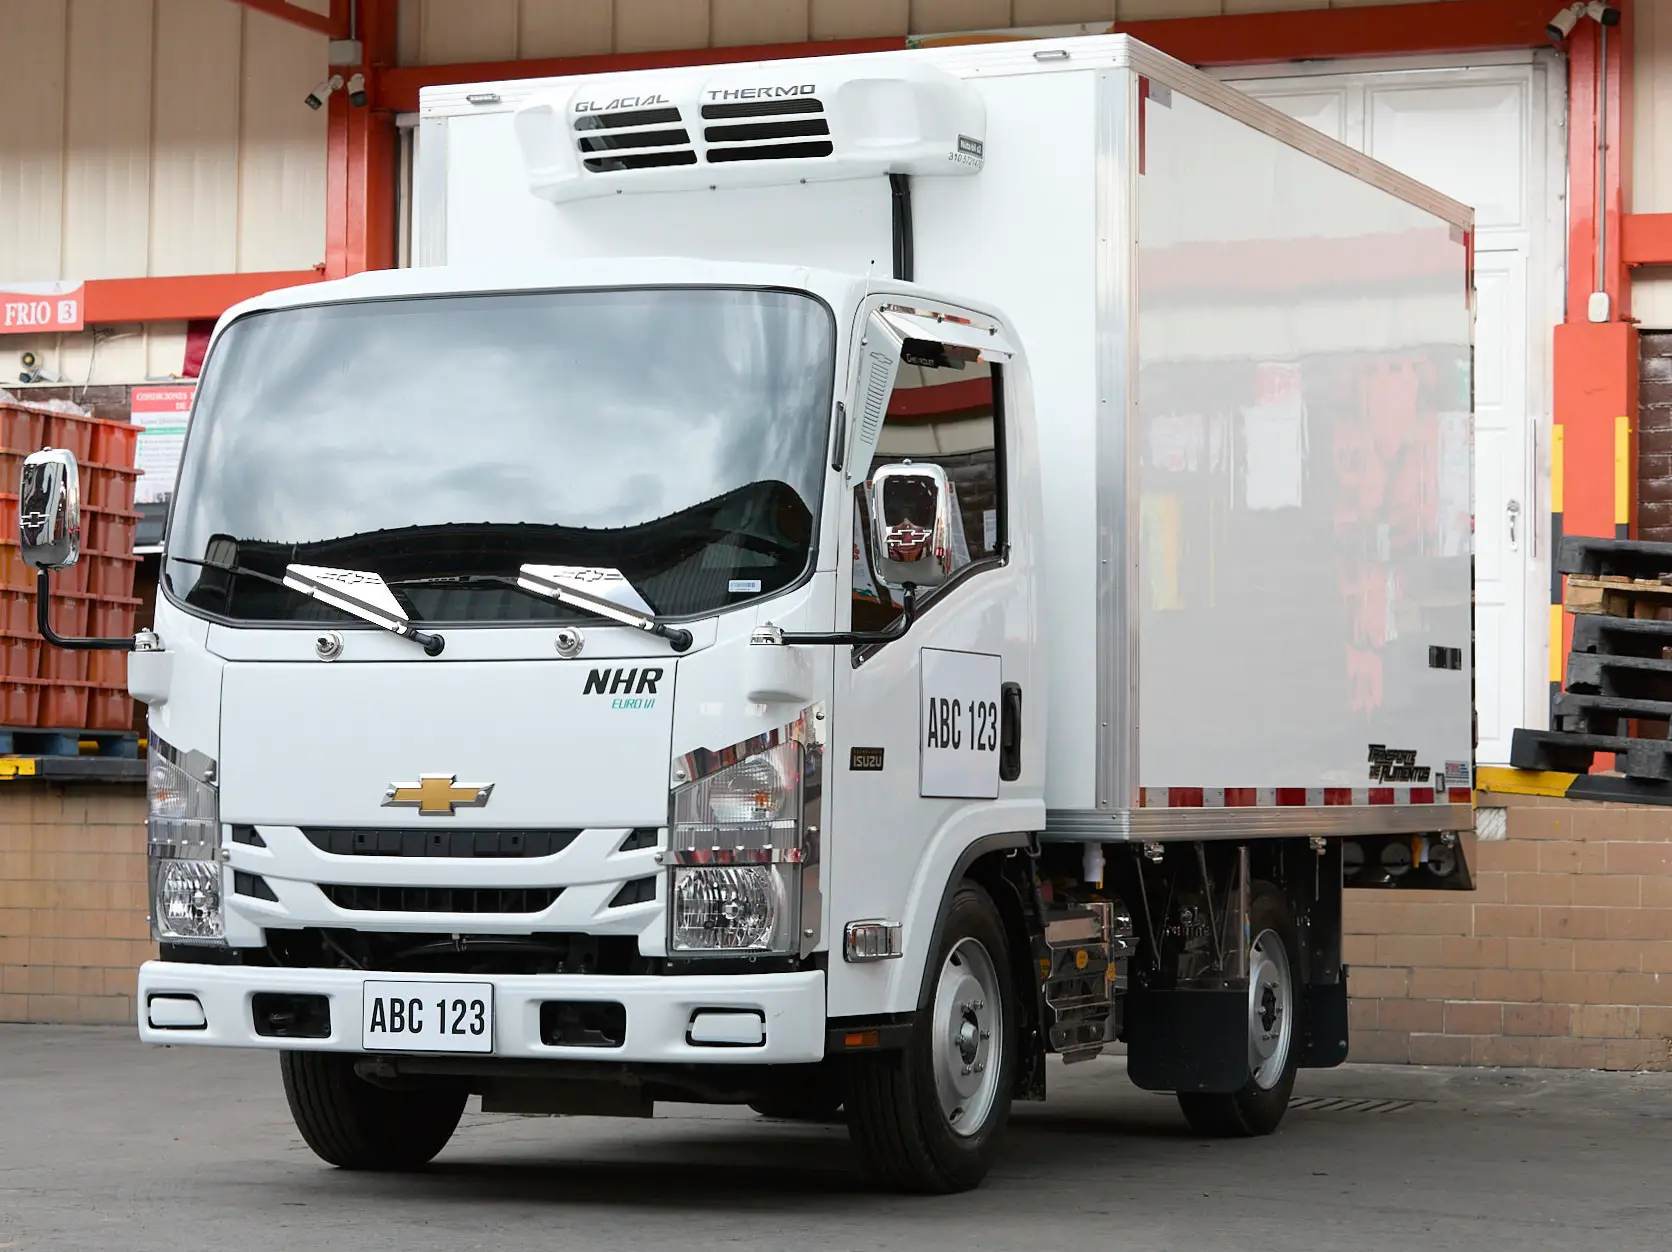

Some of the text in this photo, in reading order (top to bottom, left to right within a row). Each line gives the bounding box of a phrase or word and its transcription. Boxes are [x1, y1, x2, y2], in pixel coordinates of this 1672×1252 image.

[575, 84, 816, 113] GLACIAL THERMO
[4, 301, 51, 327] FRIO
[583, 668, 664, 695] NHR
[612, 698, 656, 709] EURO VI
[927, 697, 997, 752] ABC 123
[853, 755, 882, 768] ISUZU
[370, 998, 485, 1036] ABC 123
